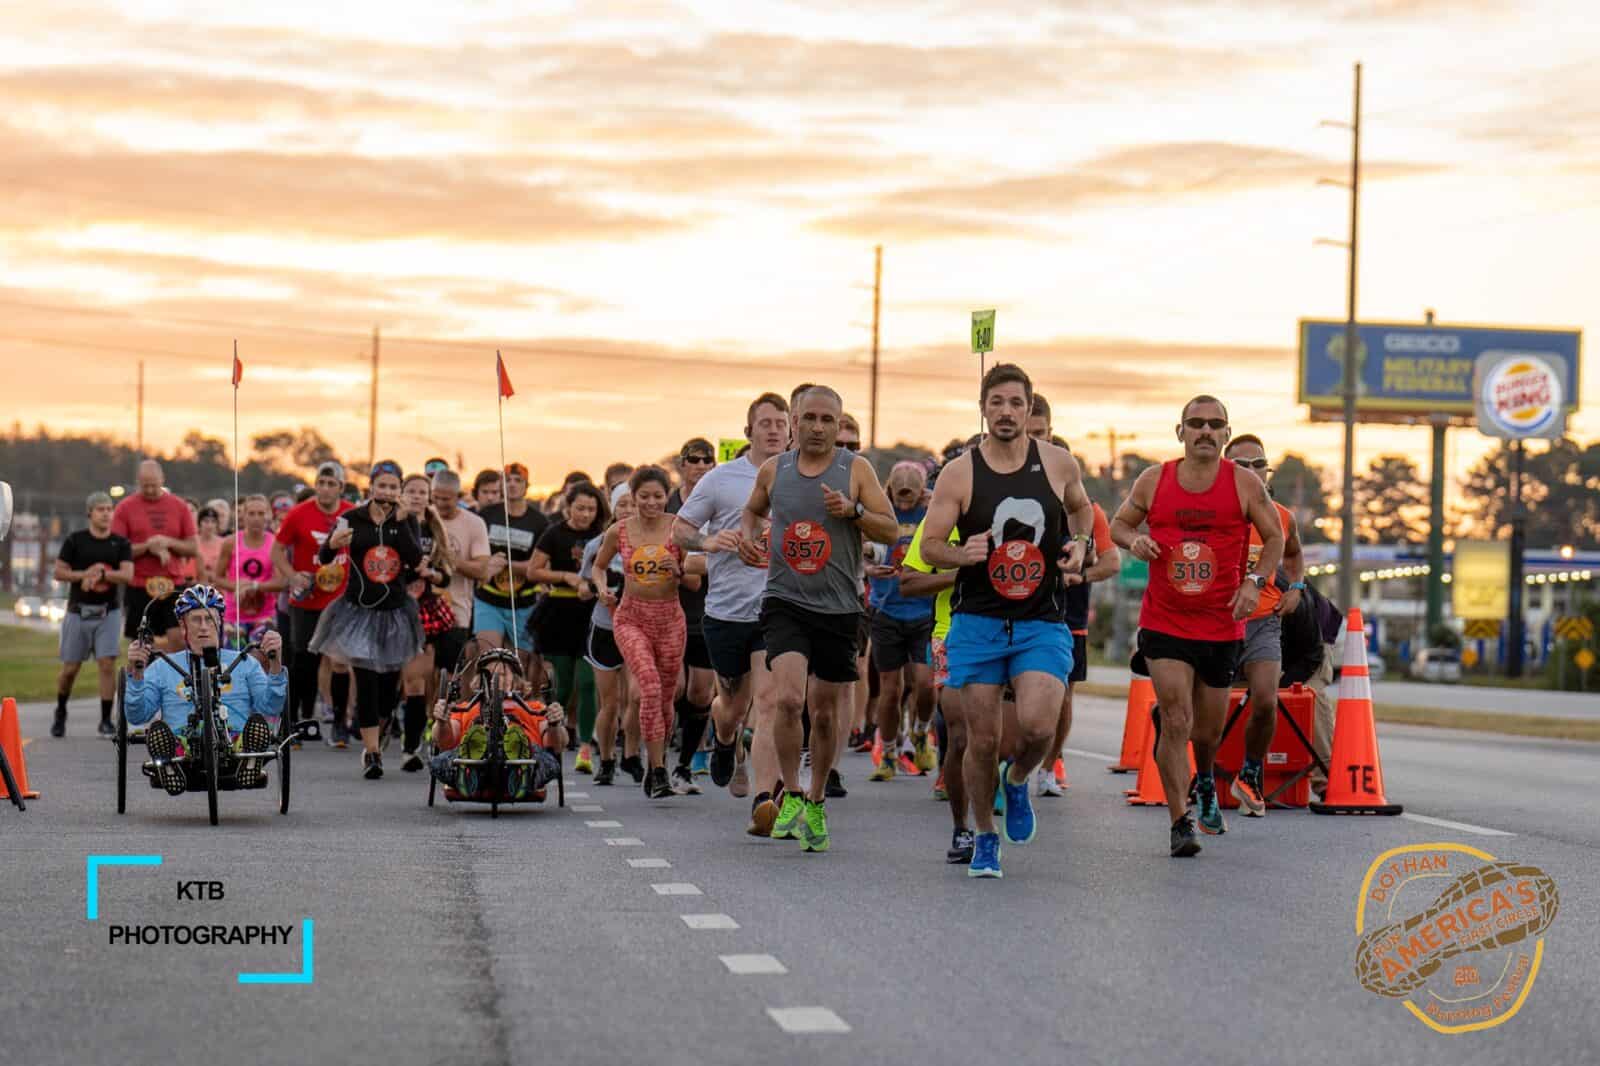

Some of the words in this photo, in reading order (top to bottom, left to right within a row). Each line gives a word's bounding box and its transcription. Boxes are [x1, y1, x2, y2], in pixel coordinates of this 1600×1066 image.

[1384, 334, 1460, 352] GEICO
[786, 540, 825, 558] 357
[992, 561, 1043, 583] 402
[1174, 562, 1211, 580] 318
[1347, 764, 1377, 794] TE
